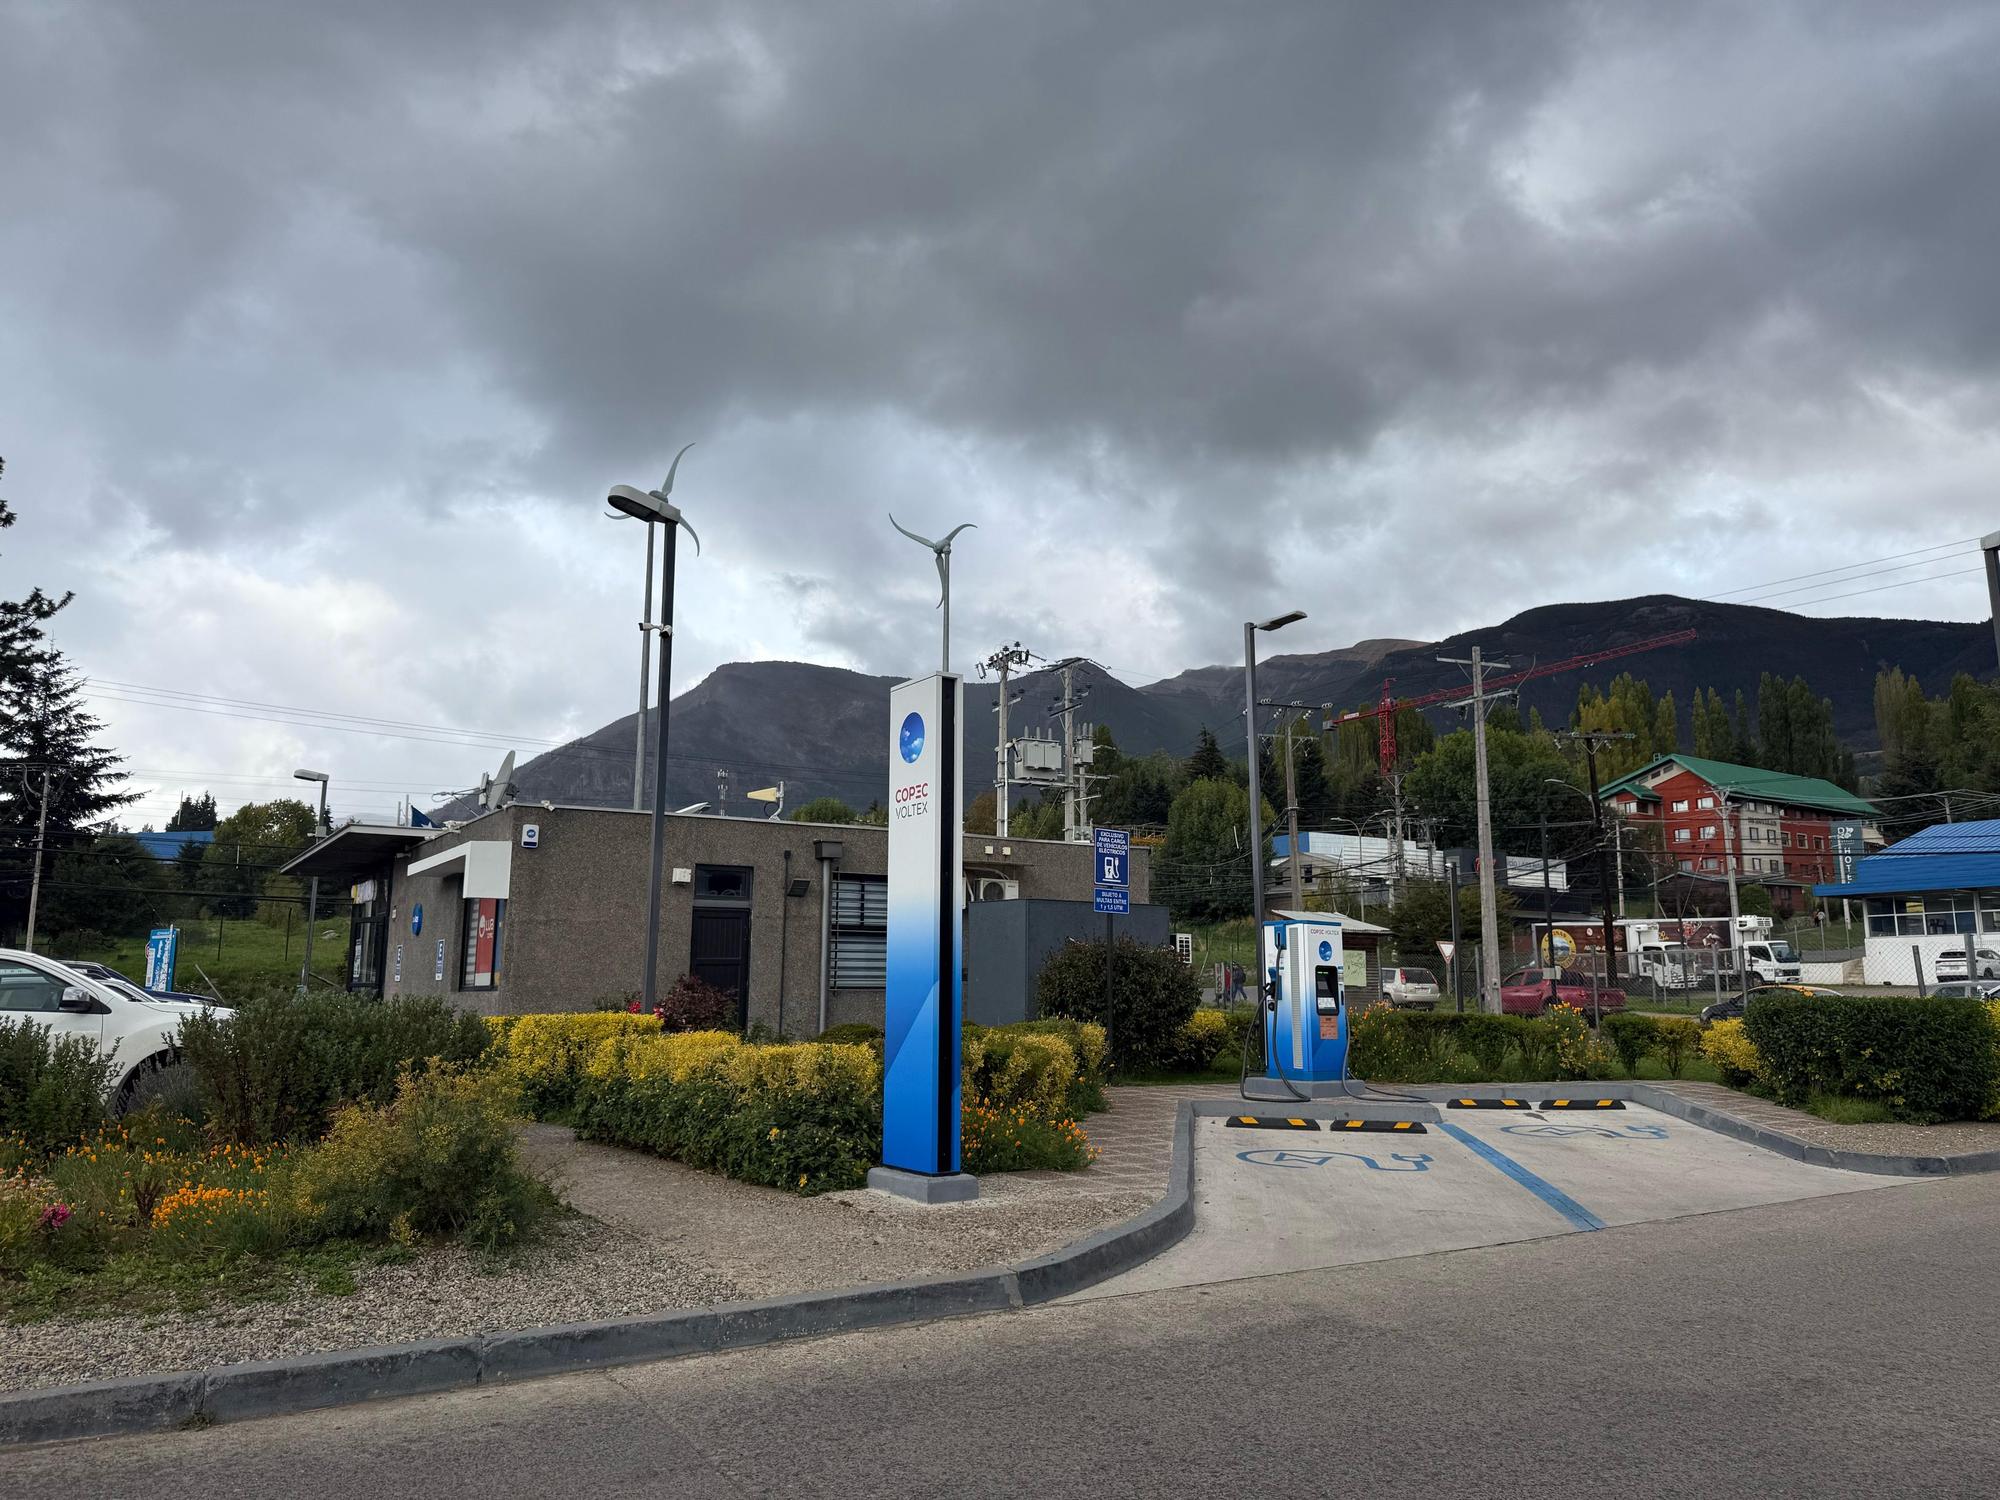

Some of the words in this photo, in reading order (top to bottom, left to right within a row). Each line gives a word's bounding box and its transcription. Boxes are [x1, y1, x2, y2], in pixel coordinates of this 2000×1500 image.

[896, 783, 929, 803] COPEC
[896, 801, 928, 819] VOLTEX
[1100, 831, 1124, 839] EXCLUSIVO
